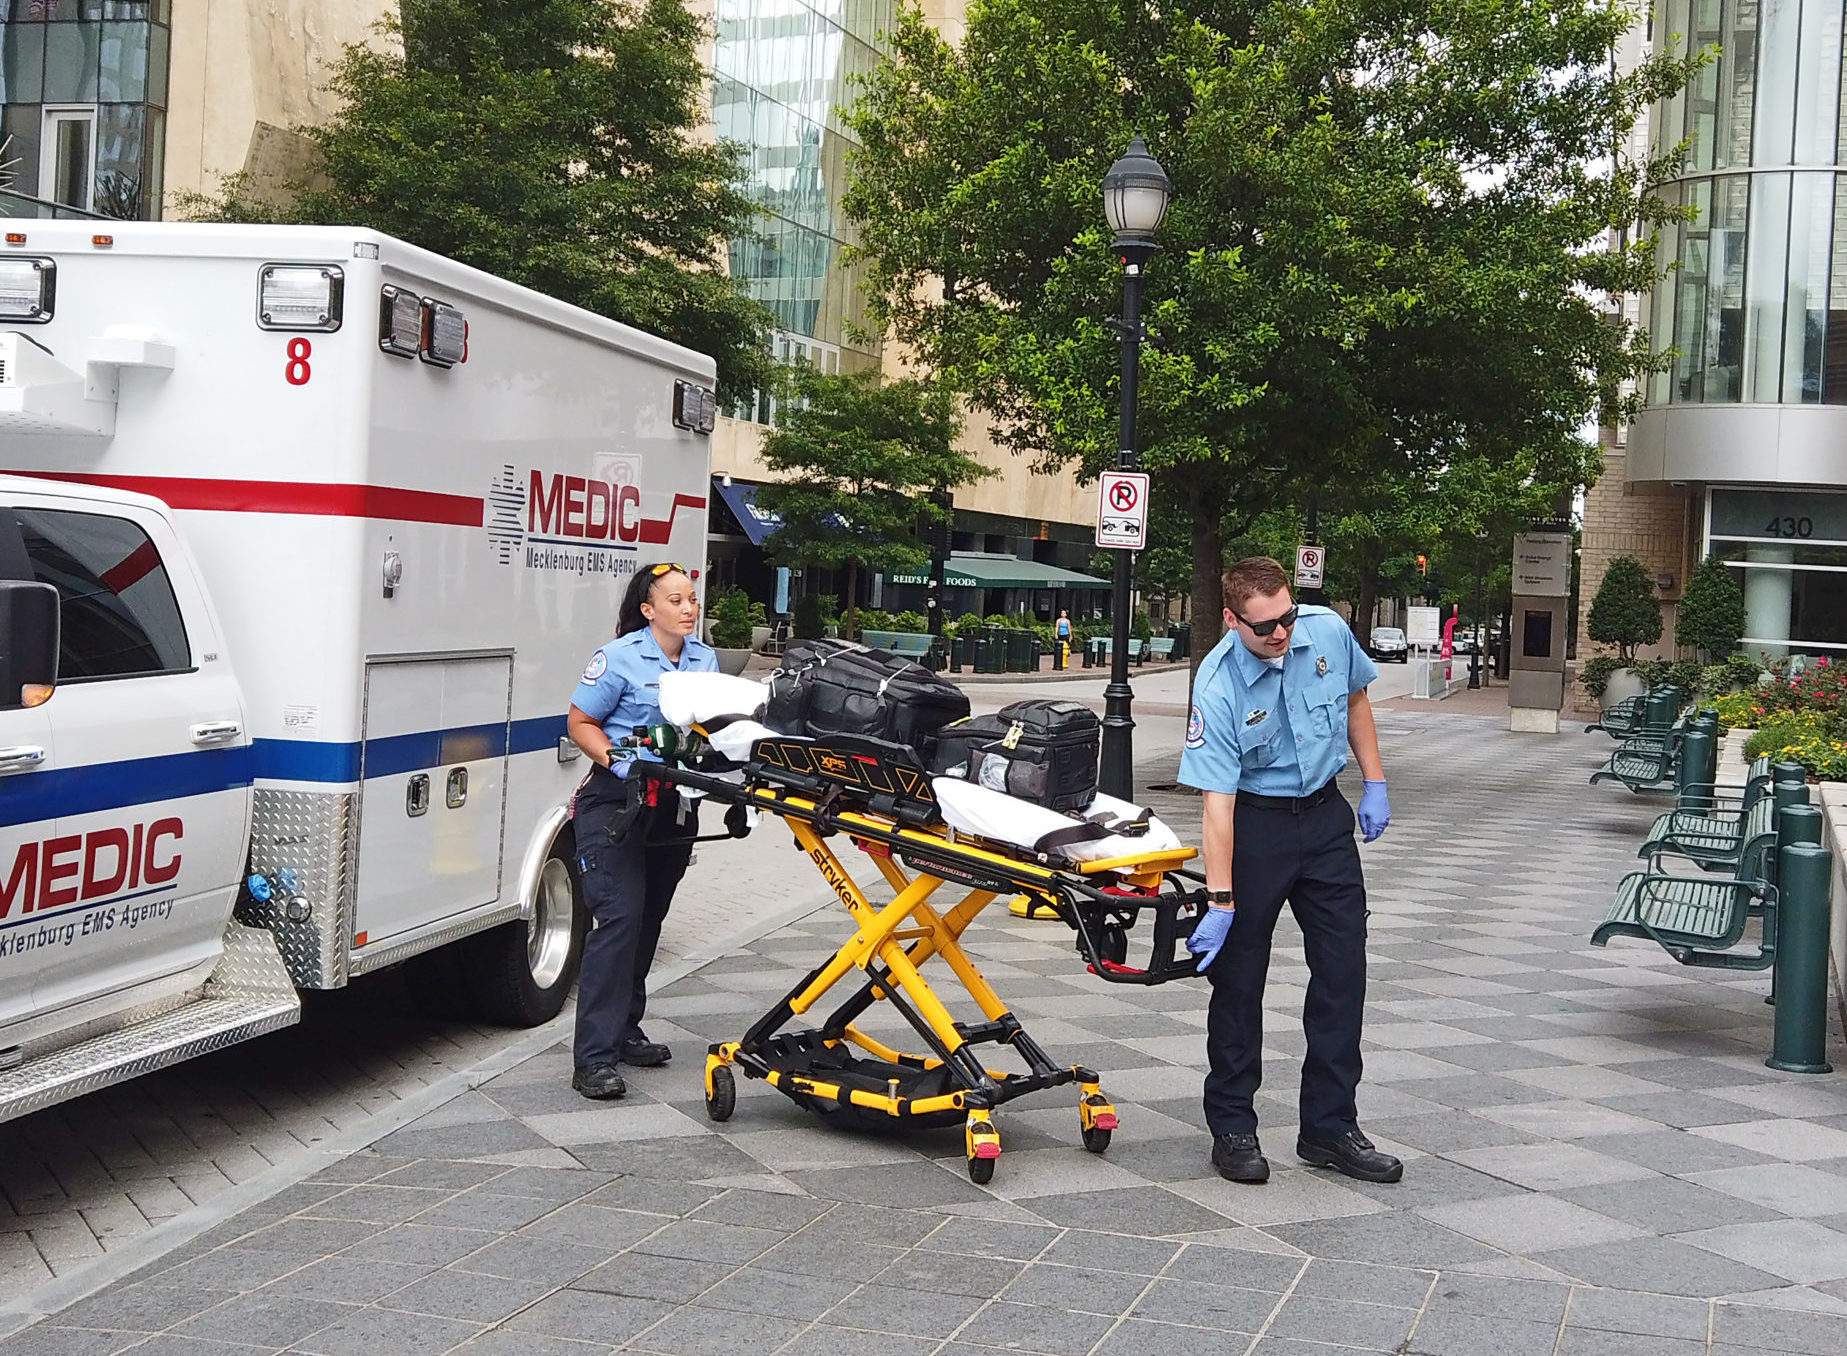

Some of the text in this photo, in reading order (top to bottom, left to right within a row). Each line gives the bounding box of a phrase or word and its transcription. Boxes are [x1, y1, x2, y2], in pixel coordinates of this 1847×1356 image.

[285, 337, 312, 386] 8
[528, 469, 640, 543] MEDIC
[1765, 516, 1813, 538] 430
[526, 547, 637, 578] Mecklenburg EMS Agency
[893, 574, 922, 585] REID'S
[946, 577, 977, 587] FOODS
[821, 755, 847, 770] XPS
[0, 817, 183, 919] MEDIC
[810, 849, 859, 911] stryker
[0, 899, 175, 957] klenburg EMS Agency
